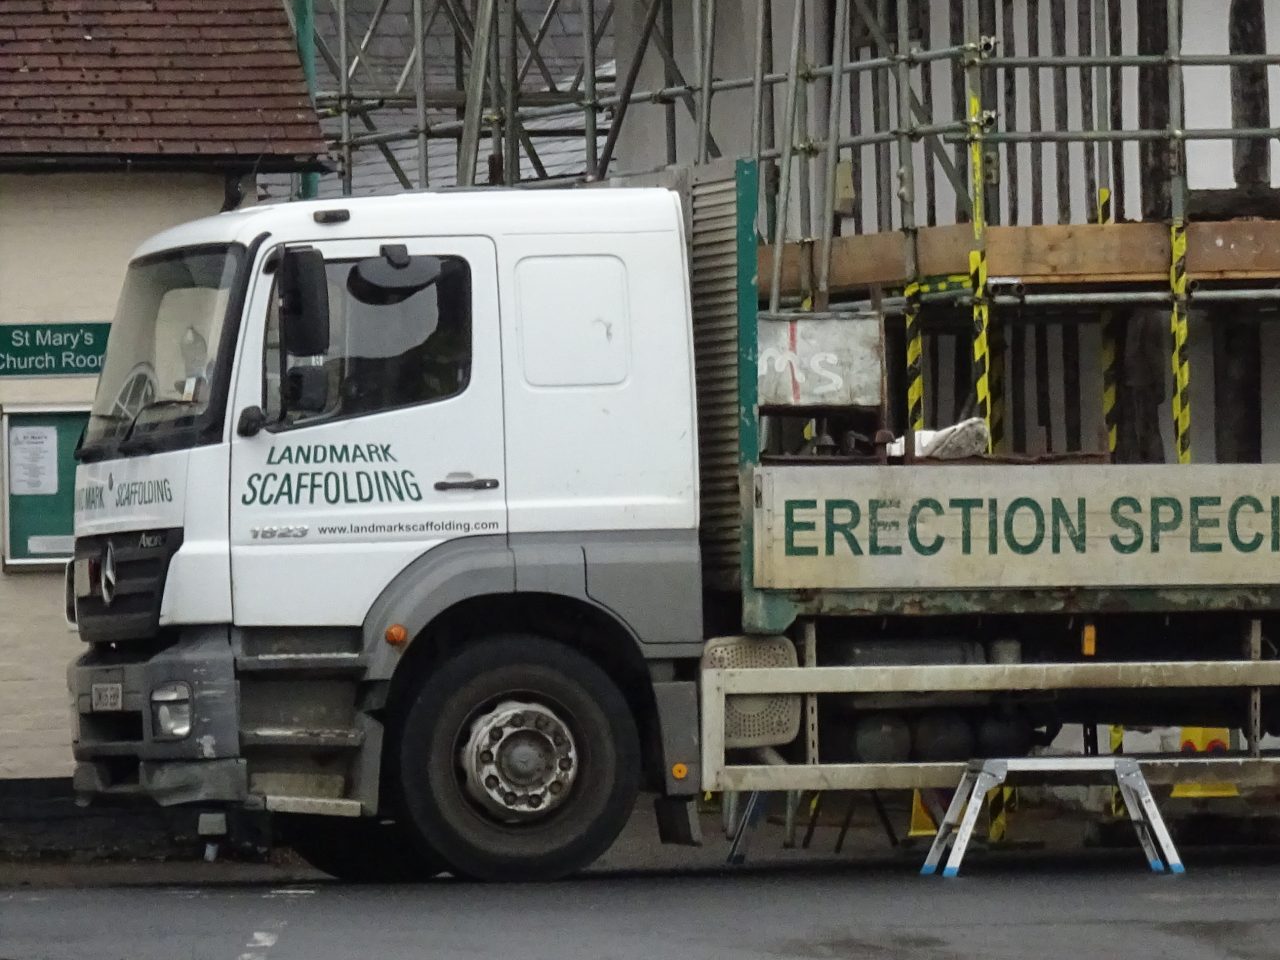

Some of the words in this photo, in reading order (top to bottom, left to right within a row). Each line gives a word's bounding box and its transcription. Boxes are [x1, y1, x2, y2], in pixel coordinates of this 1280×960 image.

[12, 329, 30, 347] St
[36, 329, 95, 349] Mary's
[266, 443, 397, 465] LANDMARK
[116, 478, 173, 507] SCAFFOLDING
[241, 470, 423, 505] SCAFFOLDING
[317, 520, 499, 535] www.landmarkscaffolding.com
[783, 497, 1088, 557] ERECTION
